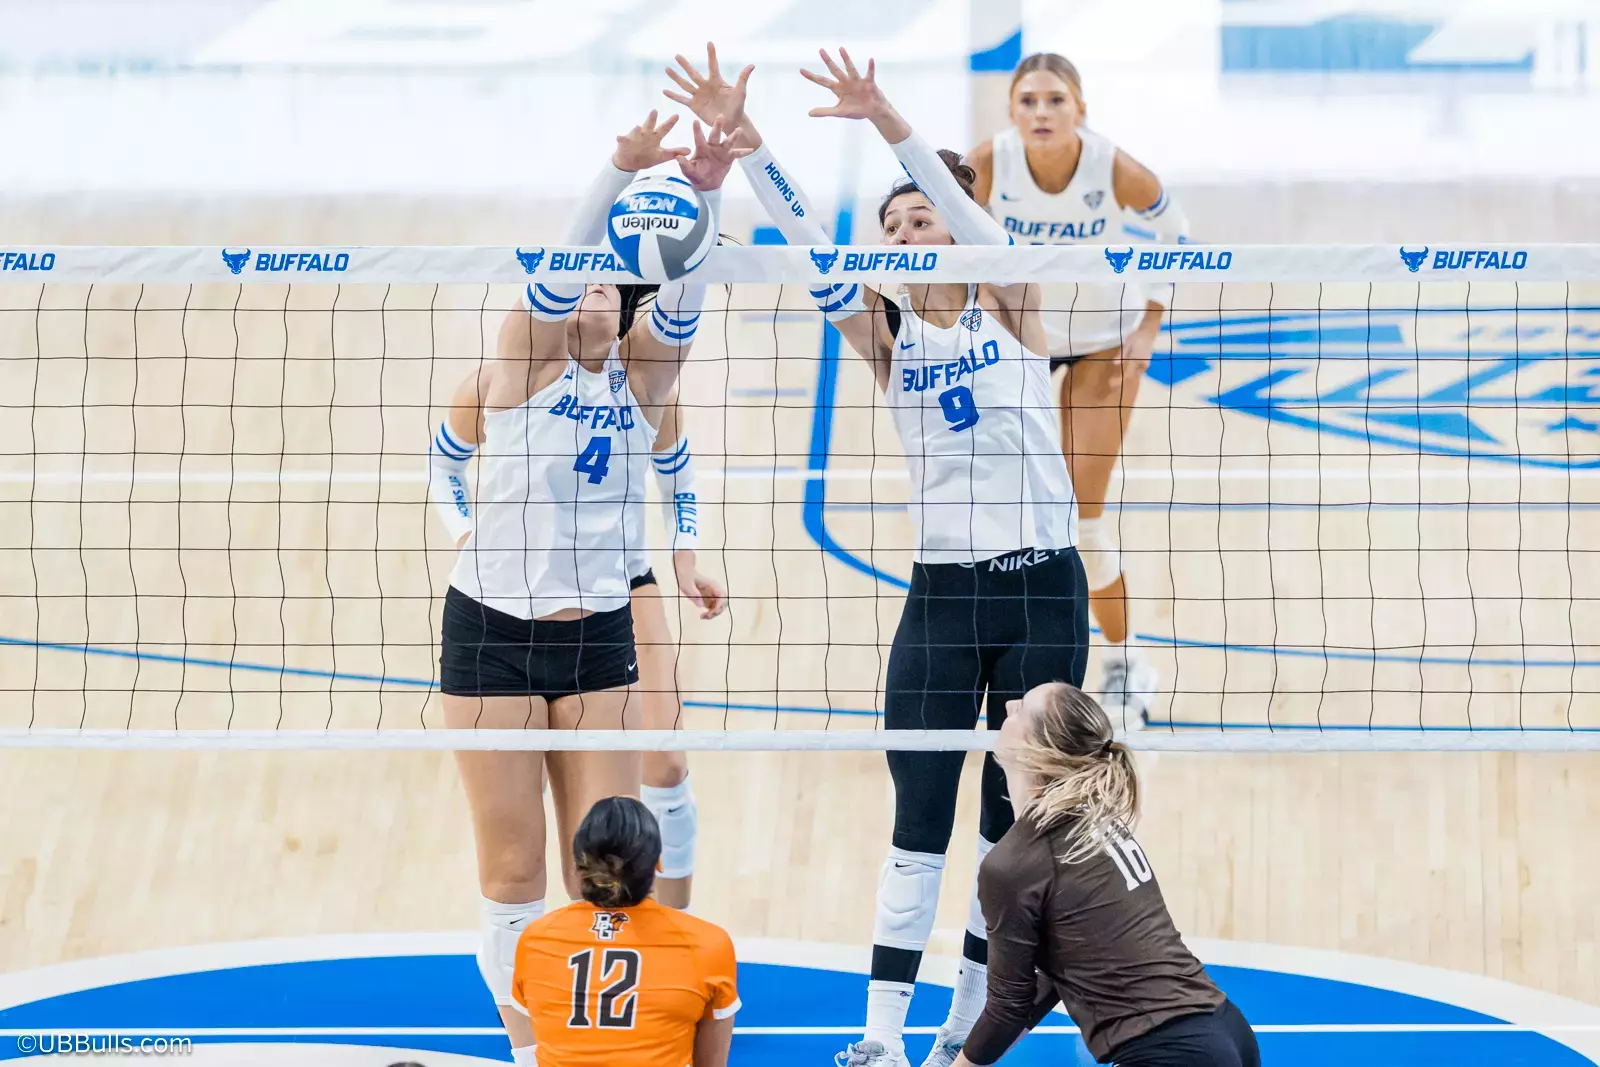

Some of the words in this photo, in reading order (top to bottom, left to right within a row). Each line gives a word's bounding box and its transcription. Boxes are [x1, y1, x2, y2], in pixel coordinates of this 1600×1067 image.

[764, 161, 796, 203] HORNS
[790, 198, 806, 219] UP
[625, 196, 678, 212] NCAA
[621, 216, 680, 232] molten
[1003, 216, 1107, 239] BUFFALO
[0, 252, 56, 271] FALO
[254, 252, 350, 272] BUFFALO
[842, 252, 938, 271] BUFFALO
[1137, 251, 1233, 271] BUFFALO
[1432, 251, 1528, 270] BUFFALO
[902, 339, 1000, 392] BUFFALO
[548, 394, 635, 432] BUFFAO
[938, 385, 980, 433] 9
[572, 436, 612, 485] 4
[674, 492, 698, 537] BULLS
[988, 550, 1050, 572] NIKE
[566, 948, 642, 1030] 12
